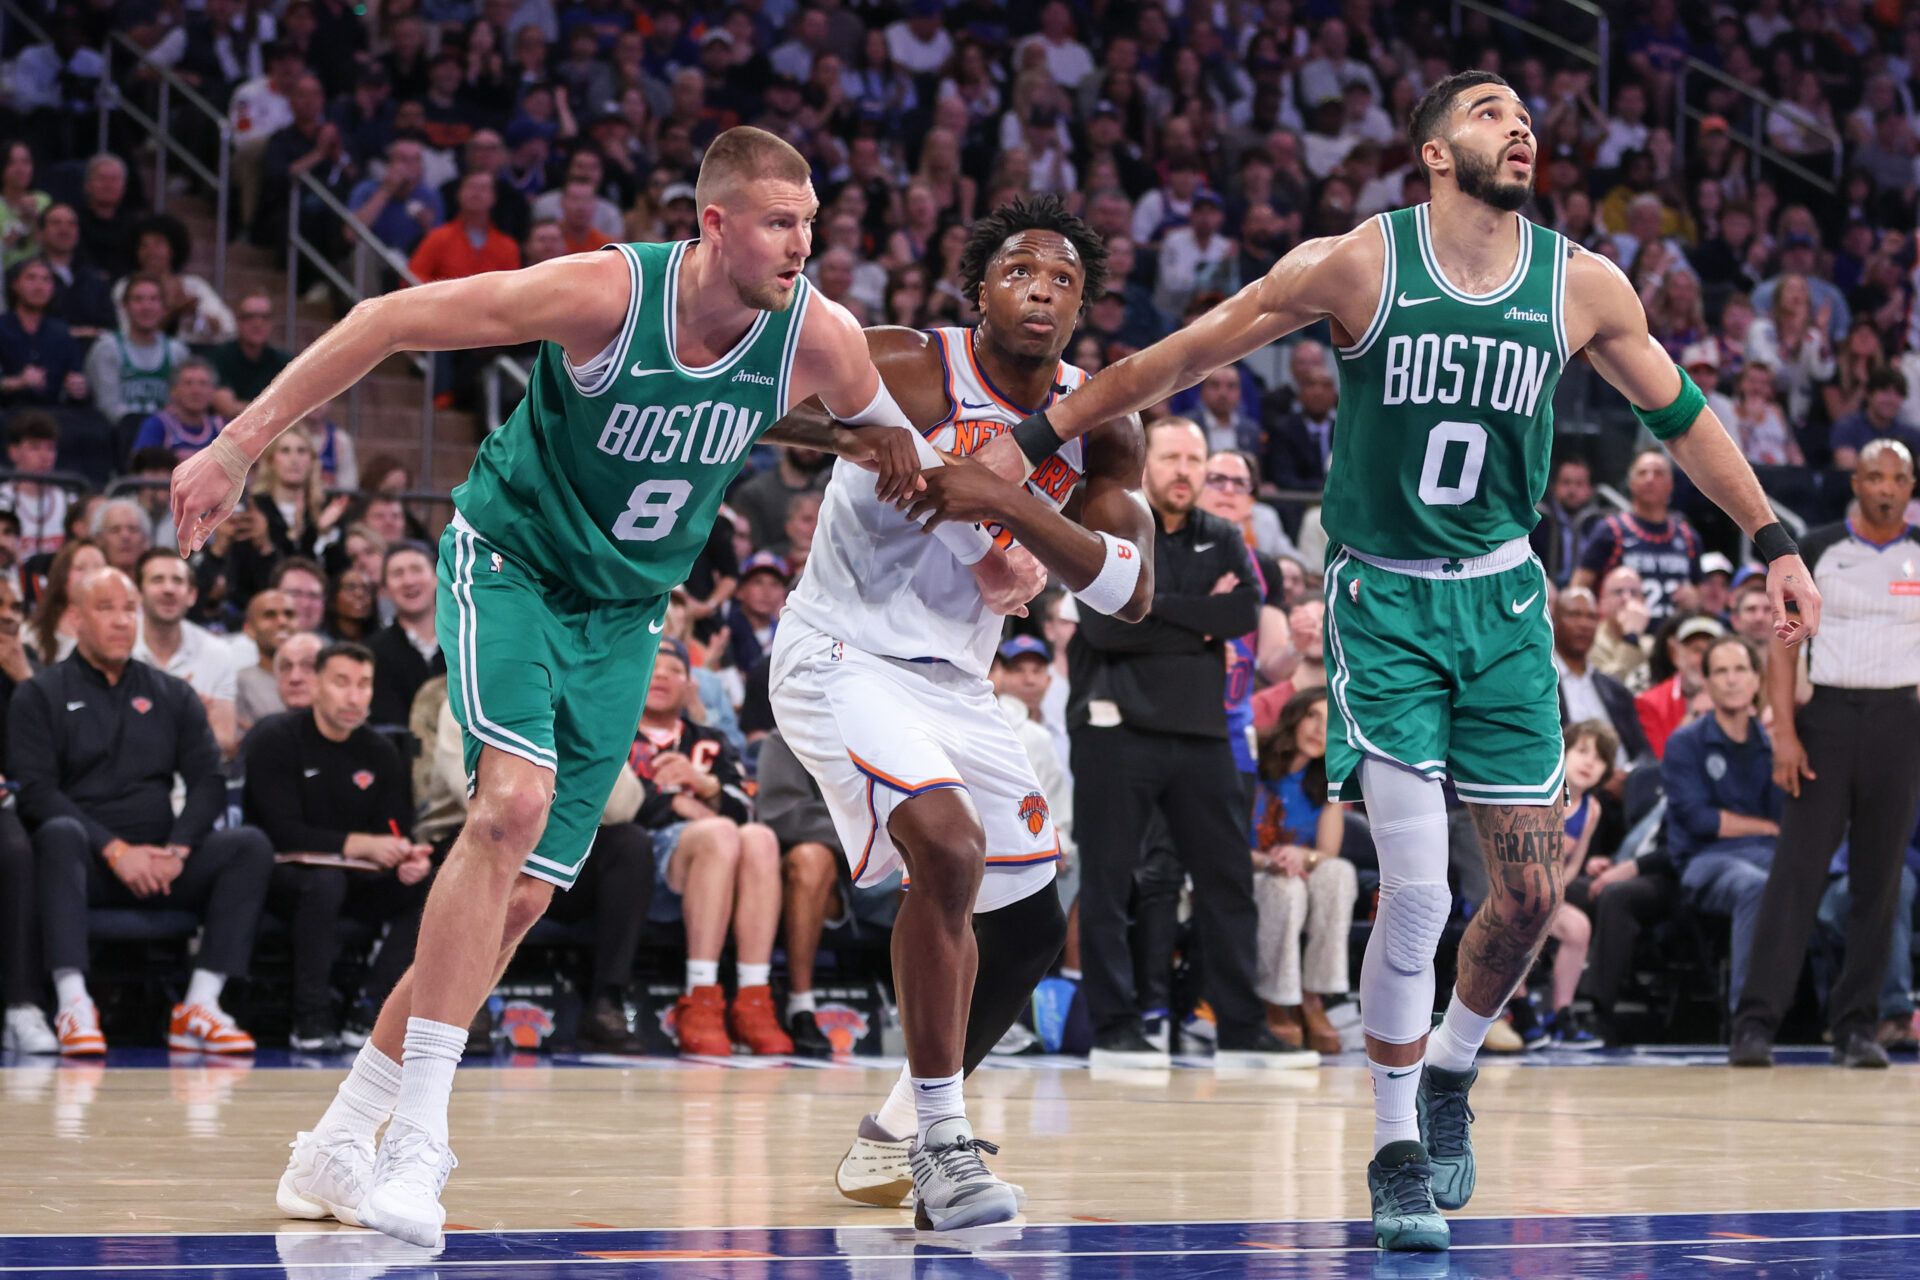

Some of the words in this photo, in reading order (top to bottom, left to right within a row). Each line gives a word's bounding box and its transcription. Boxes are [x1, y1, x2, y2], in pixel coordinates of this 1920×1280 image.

[1504, 306, 1548, 323] Amica
[731, 369, 774, 386] Amica
[1383, 333, 1551, 417] BOSTON
[596, 400, 763, 465] BOSTON
[1418, 421, 1488, 505] 0
[611, 479, 694, 541] 8
[1117, 544, 1132, 560] B
